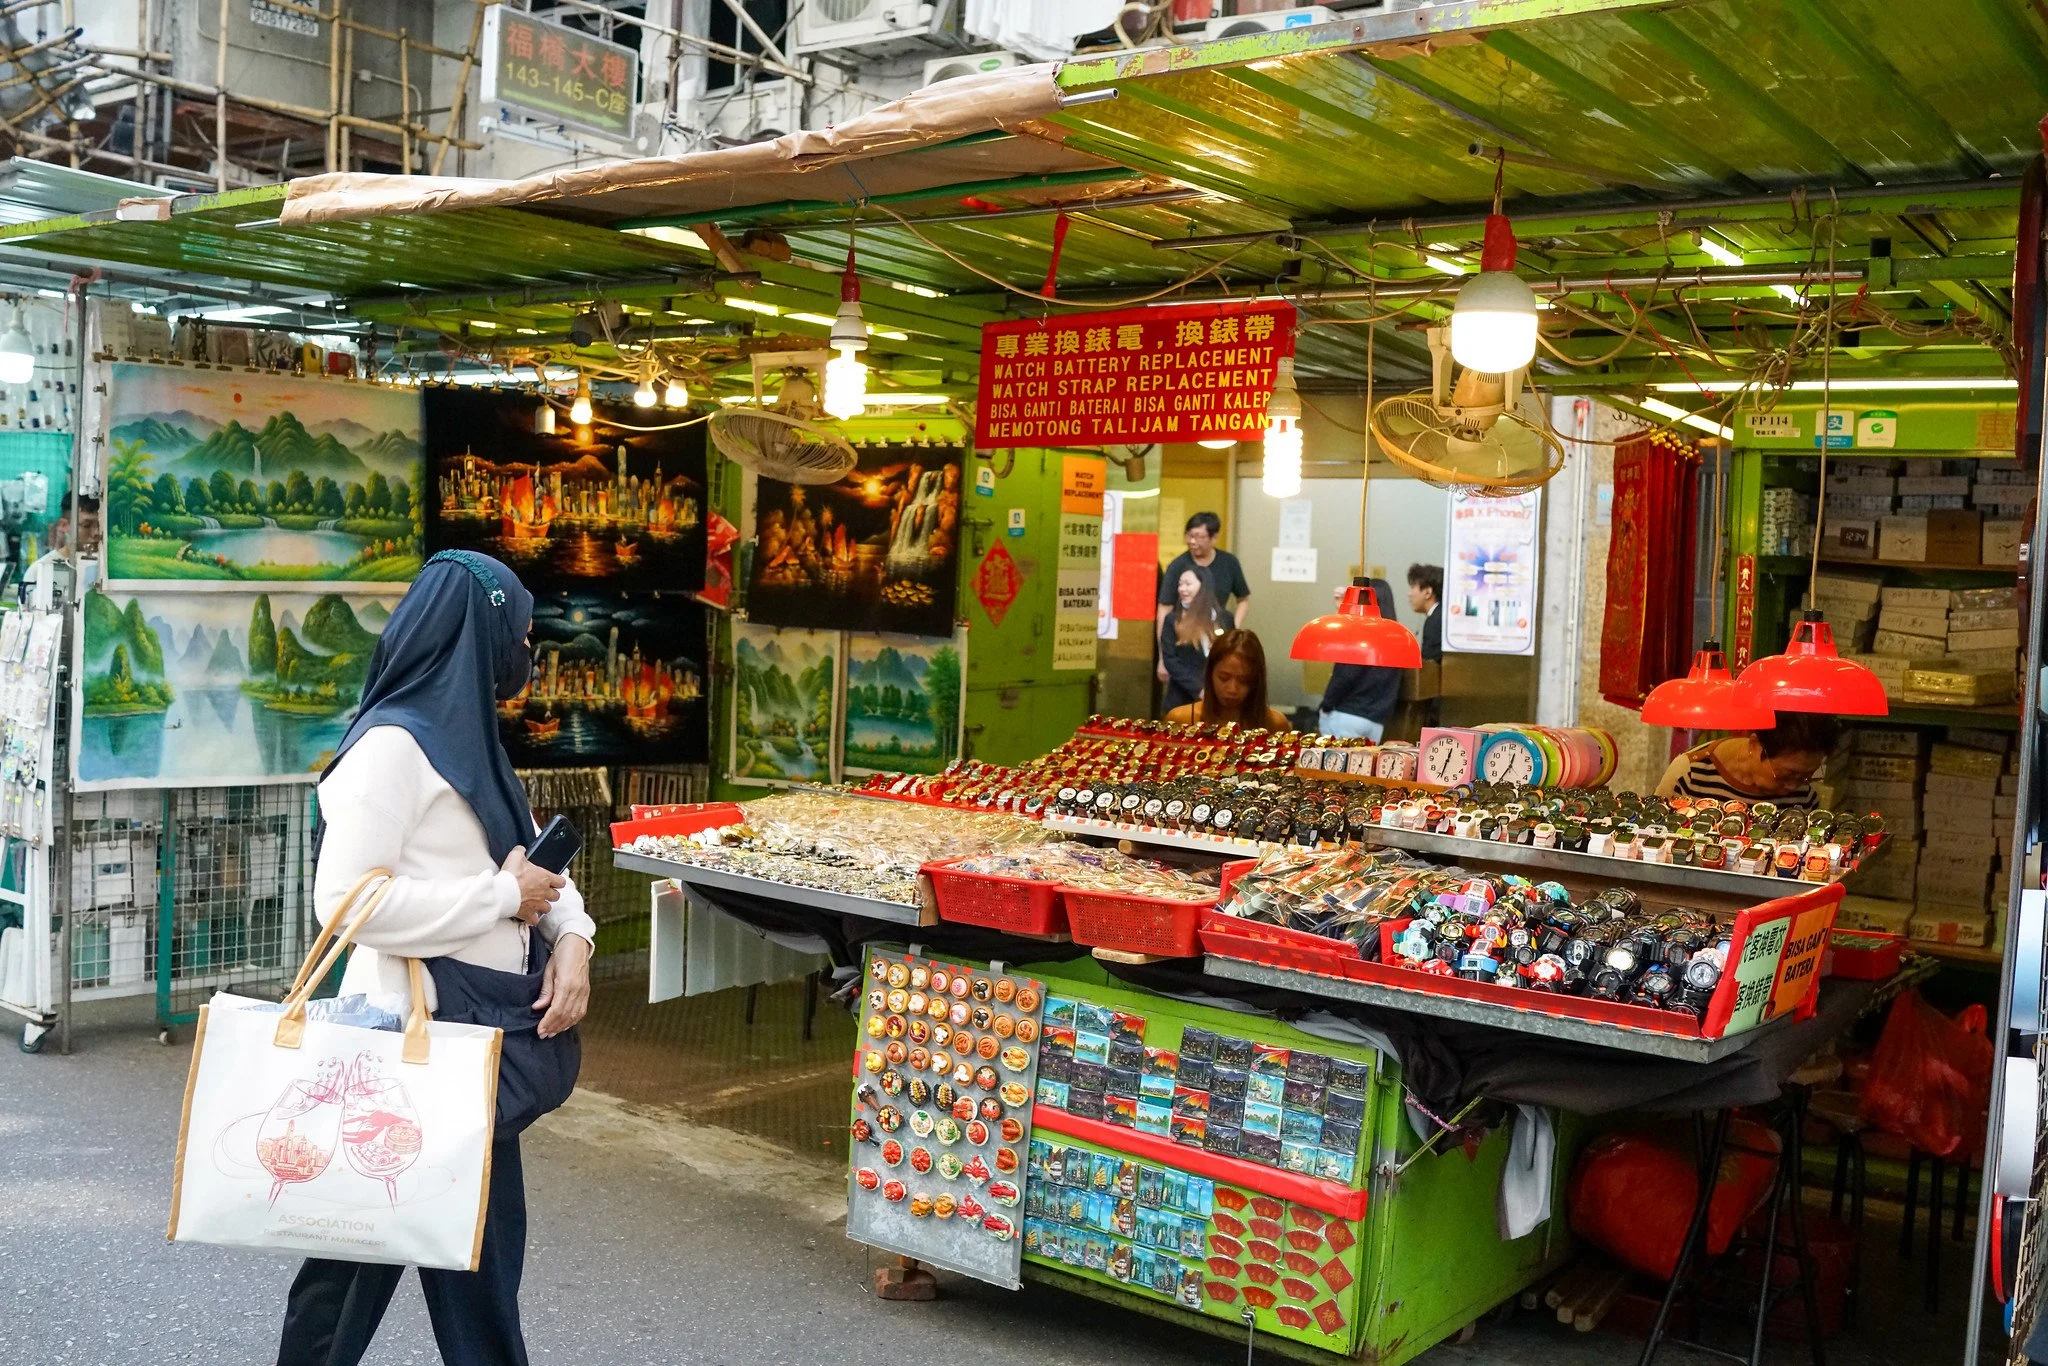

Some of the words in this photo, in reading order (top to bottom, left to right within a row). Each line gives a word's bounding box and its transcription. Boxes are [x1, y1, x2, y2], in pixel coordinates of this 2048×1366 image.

[995, 362, 1045, 379] WATCH
[1054, 356, 1131, 375] BATTERY
[1140, 347, 1274, 370] REPLACEMENT
[993, 381, 1048, 398] WATCH
[1058, 377, 1117, 395] STRAP
[1126, 369, 1272, 393] REPLACEMENT
[991, 404, 1017, 419] BISA
[1024, 401, 1061, 417] GANTI
[1070, 398, 1126, 416] BATERAI
[1134, 396, 1165, 413] BISA
[1174, 394, 1215, 411] GANTI
[989, 419, 1081, 438] MEMOTONG
[1190, 412, 1269, 431] TANGAN
[1751, 416, 1767, 426] FP
[1770, 415, 1788, 425] 114
[1058, 587, 1075, 597] BISA
[1076, 587, 1099, 597] GANTI
[1784, 938, 1805, 960] BISA
[278, 1214, 375, 1233] ASSOCIATION
[263, 1228, 329, 1242] RESTAURANT
[331, 1236, 388, 1248] MANAGERS
